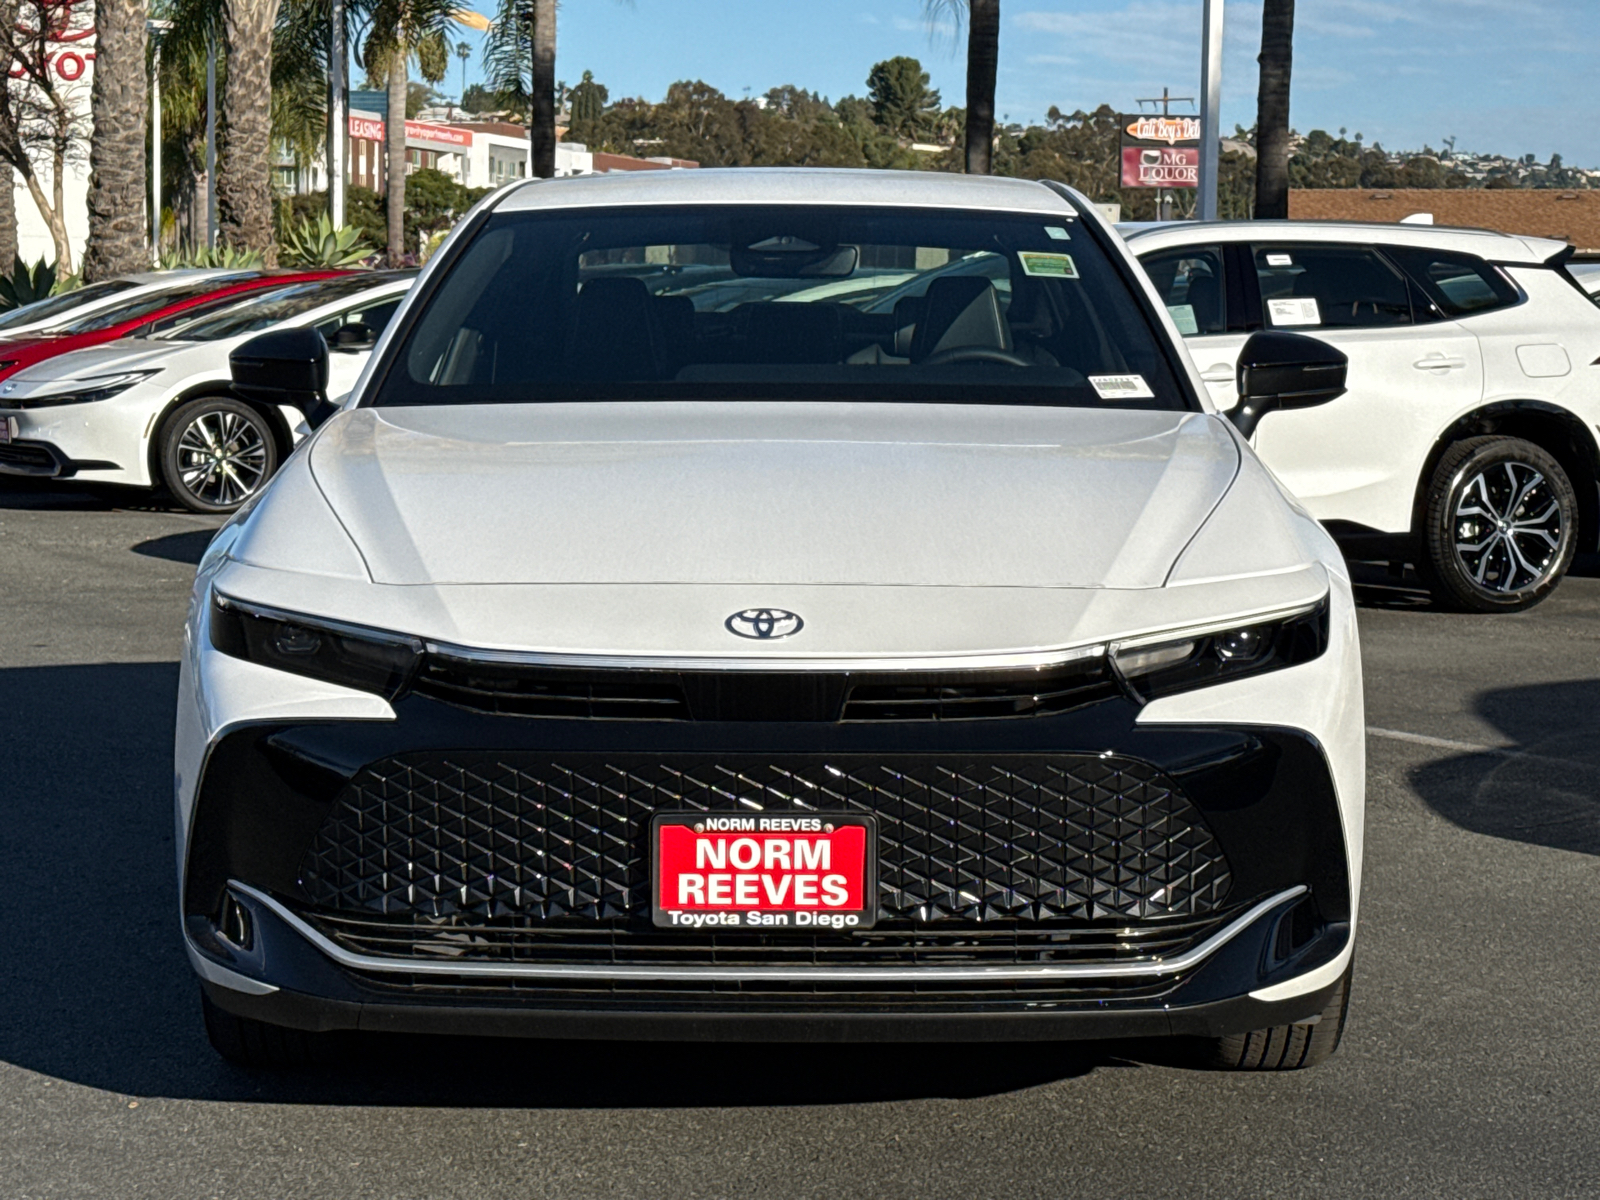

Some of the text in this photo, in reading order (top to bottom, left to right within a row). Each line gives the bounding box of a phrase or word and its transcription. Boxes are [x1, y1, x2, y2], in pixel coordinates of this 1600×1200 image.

[349, 119, 382, 140] LEASING
[1137, 117, 1156, 138] Cali
[1157, 117, 1180, 145] Boy's
[706, 818, 821, 831] NORM REEVES
[695, 838, 831, 870] NORM
[678, 873, 848, 906] REEVES
[667, 911, 859, 928] Toyota San Diego
